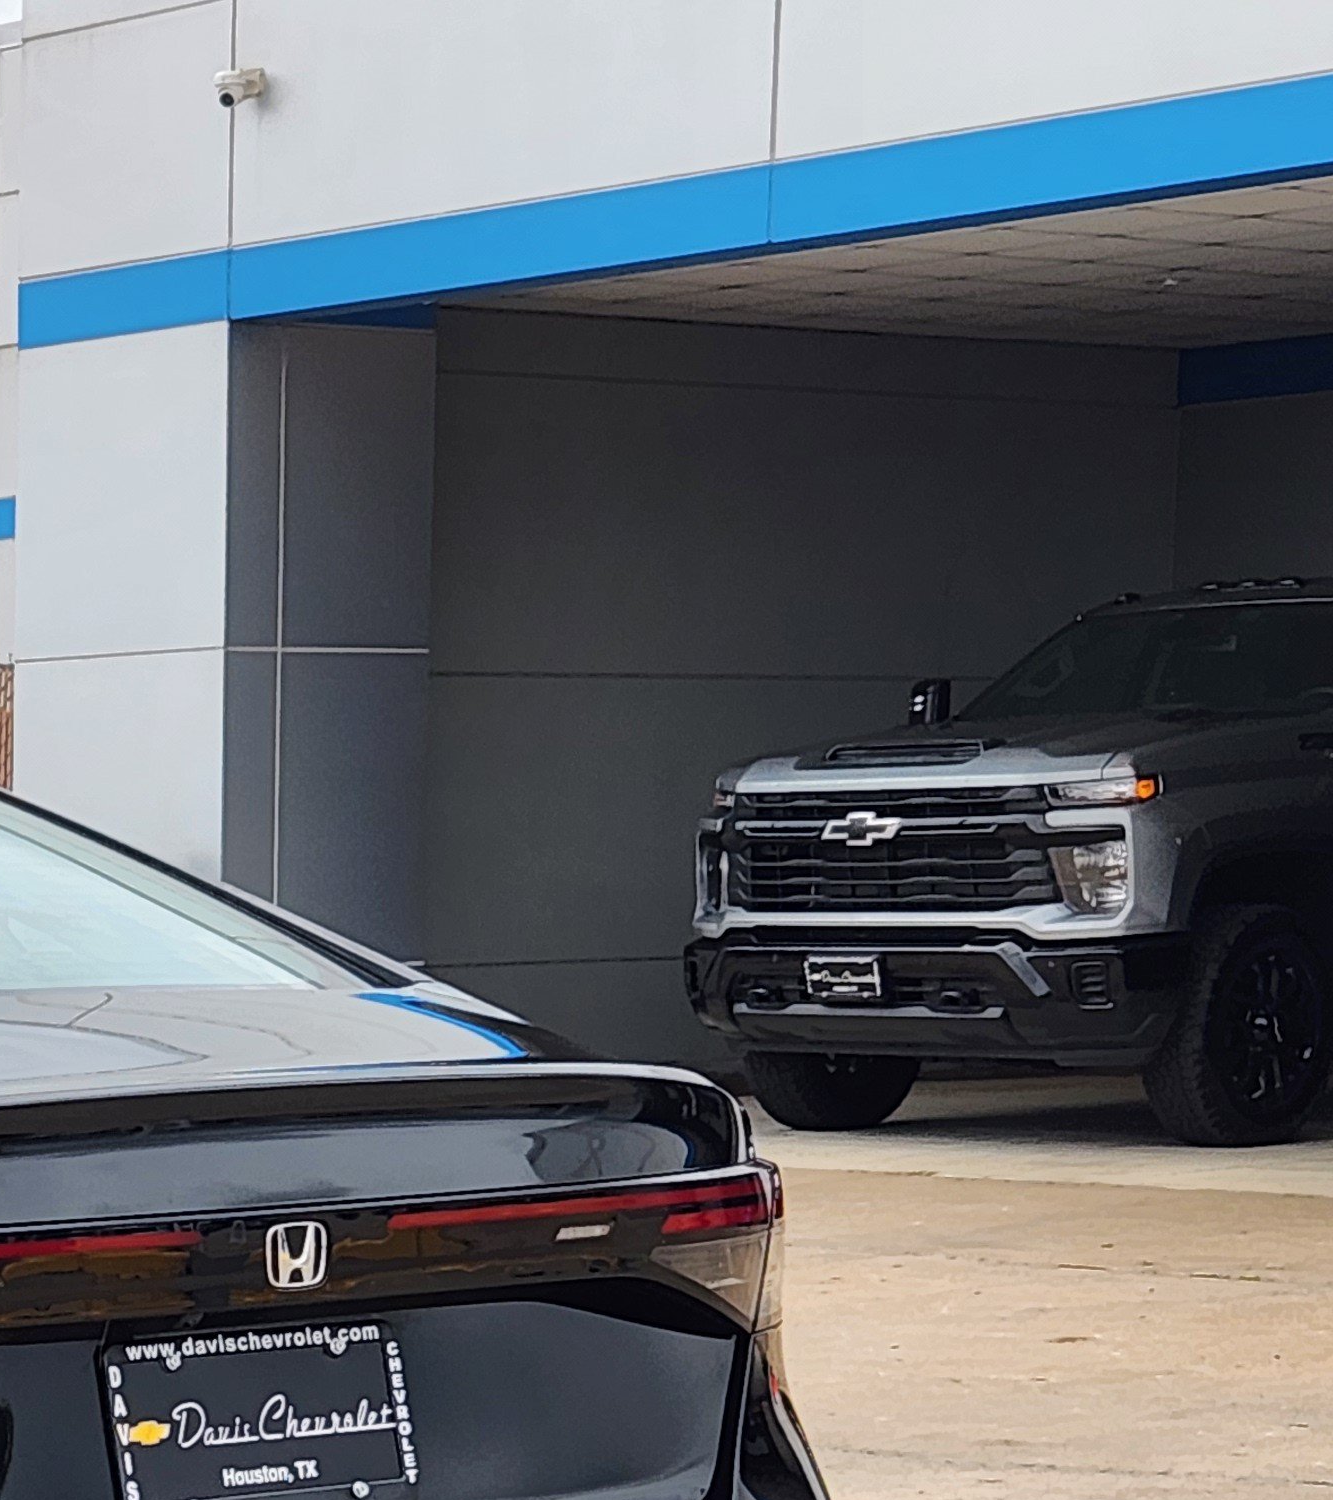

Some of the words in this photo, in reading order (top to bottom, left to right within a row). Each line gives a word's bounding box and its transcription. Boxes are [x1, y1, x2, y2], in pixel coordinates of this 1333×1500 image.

[126, 1324, 380, 1361] www.davischevrolet.com
[171, 1401, 260, 1448] Davis
[259, 1394, 397, 1442] Chevrolet
[386, 1341, 419, 1484] CHEVROLET
[222, 1465, 294, 1488] Houston,
[294, 1459, 319, 1480] TX
